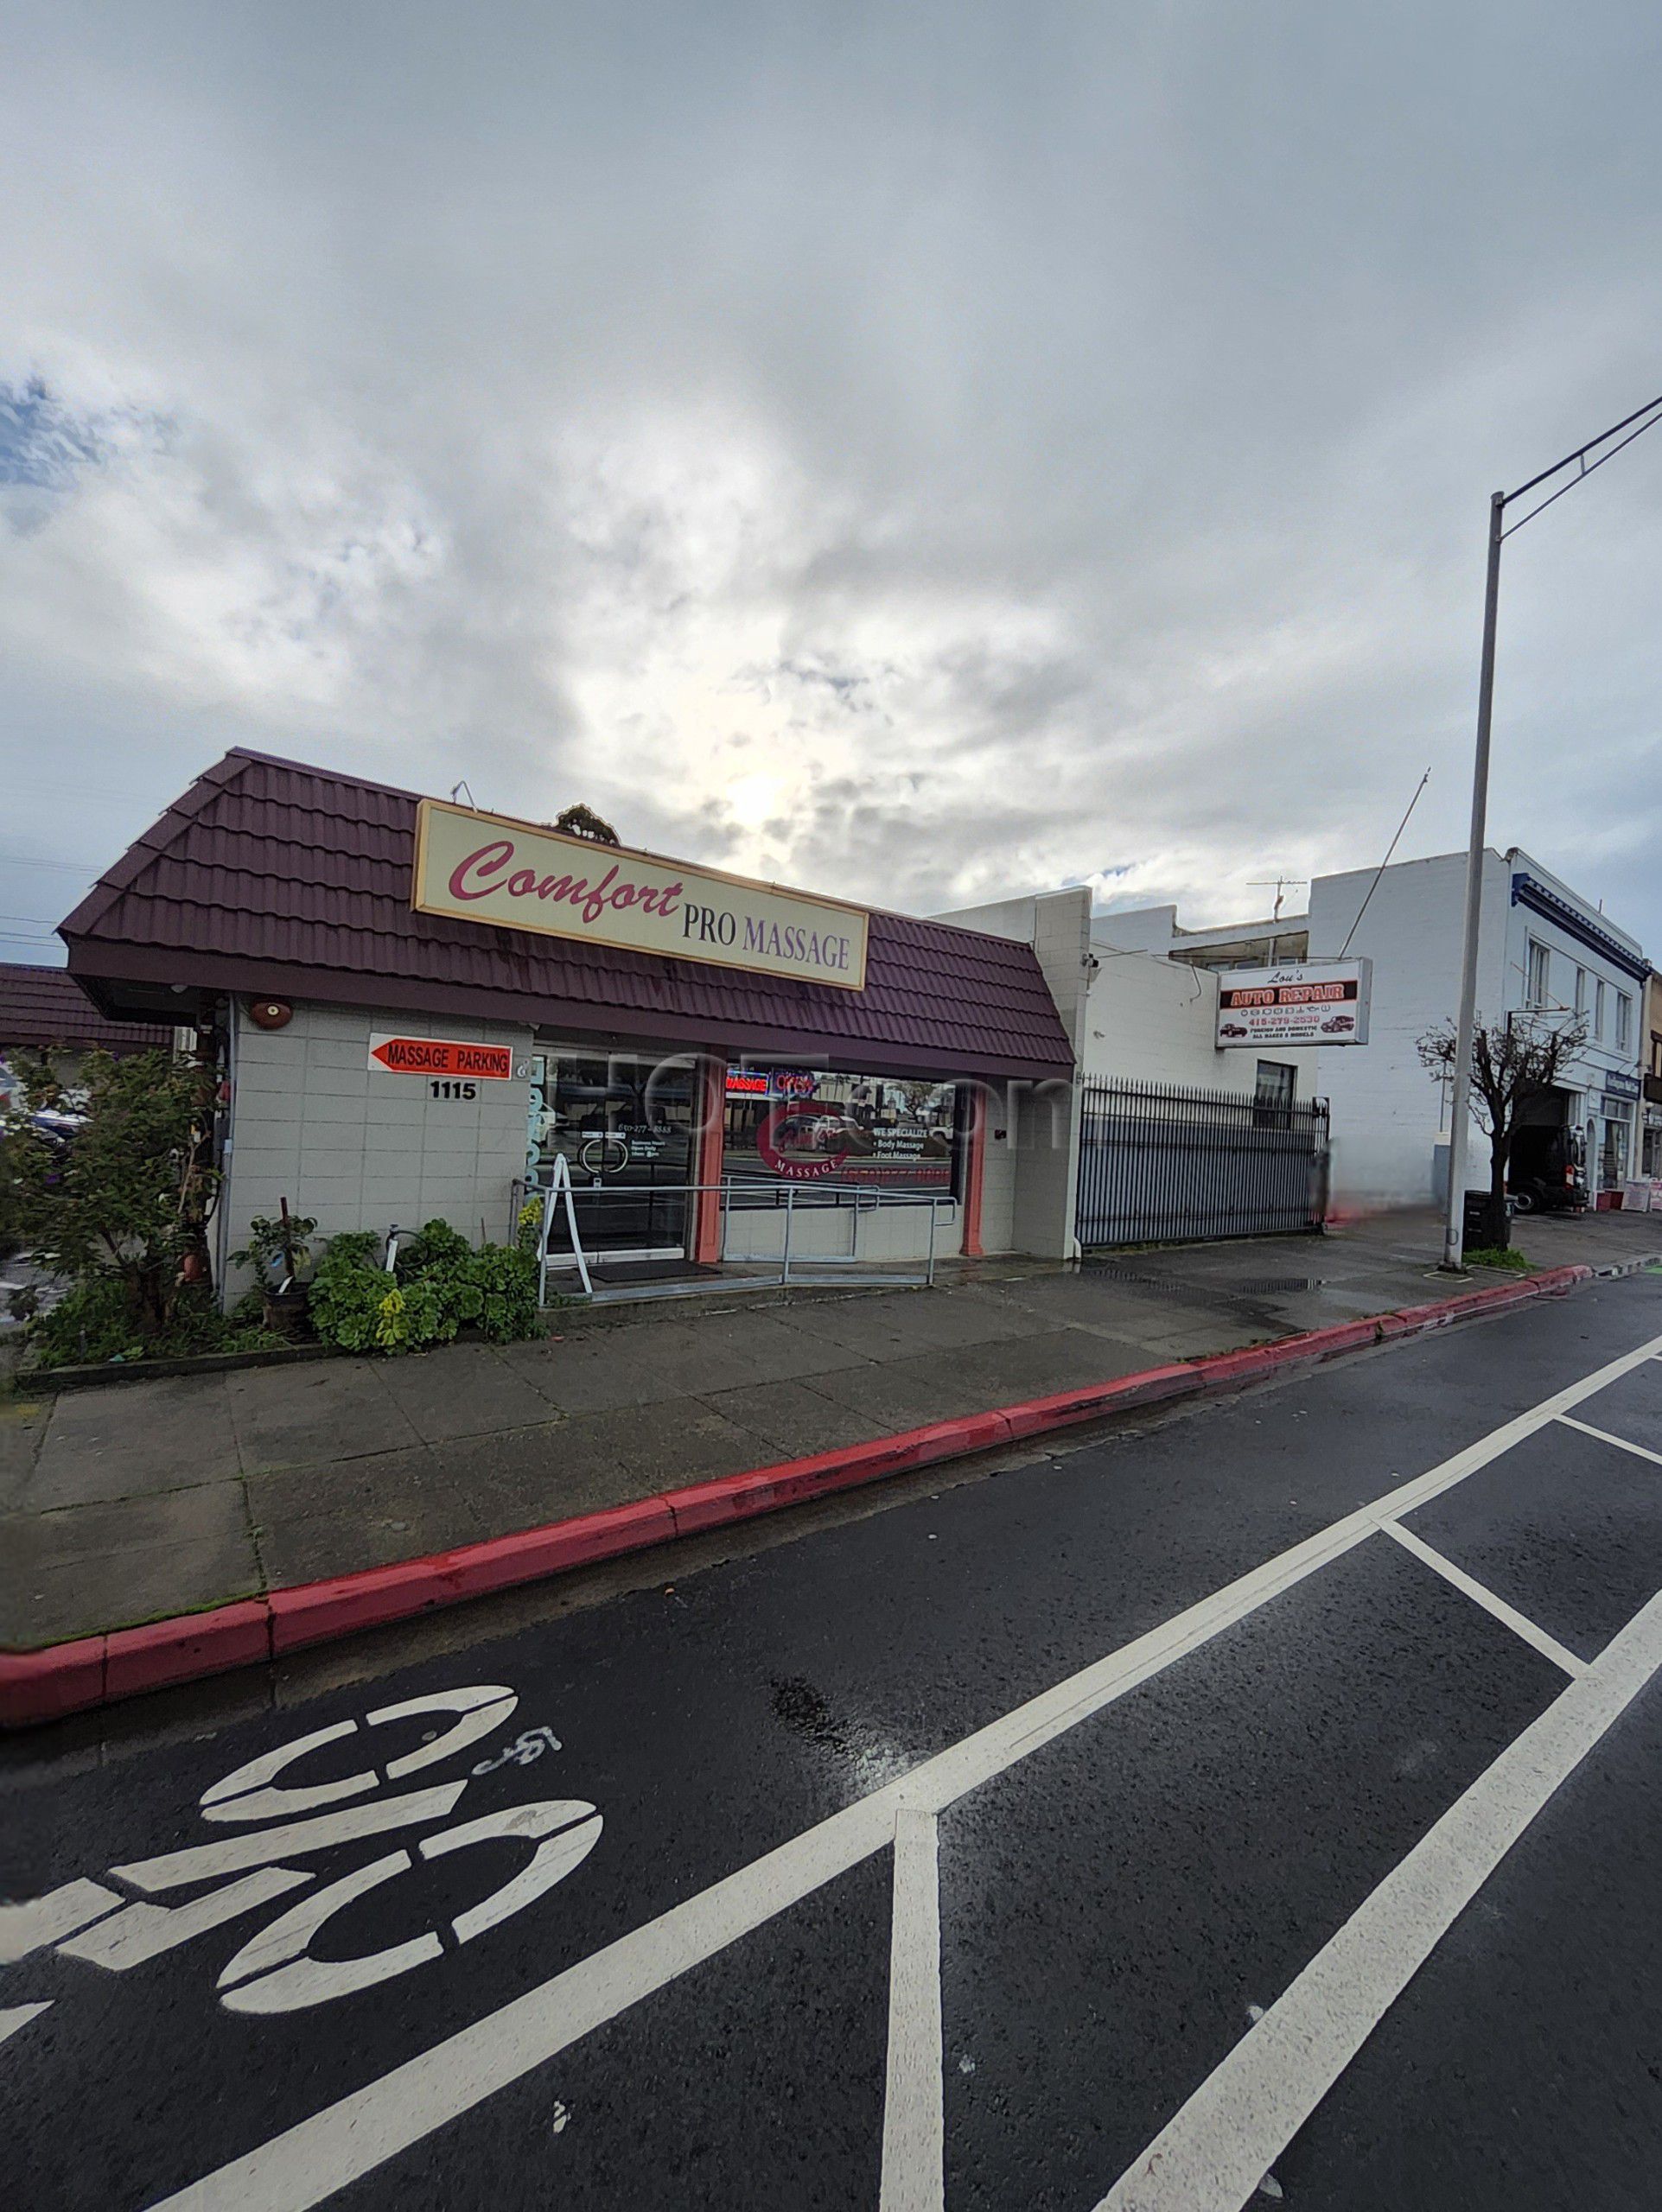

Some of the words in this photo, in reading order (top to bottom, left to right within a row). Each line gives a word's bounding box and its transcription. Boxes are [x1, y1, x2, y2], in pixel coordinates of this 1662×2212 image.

[449, 840, 685, 924] Comfort
[681, 902, 737, 946] PRO
[742, 915, 851, 972] MASSAGE
[1267, 969, 1303, 984] Lou's
[1231, 989, 1275, 1007] AUTO
[1279, 984, 1345, 1003] REPAIR
[387, 1044, 449, 1069] MASSAGE
[456, 1049, 509, 1073] PARKING
[430, 1080, 476, 1100] 1115
[877, 1139, 895, 1149] Body
[895, 1140, 925, 1151] Massage
[774, 1159, 838, 1179] MASSAGE
